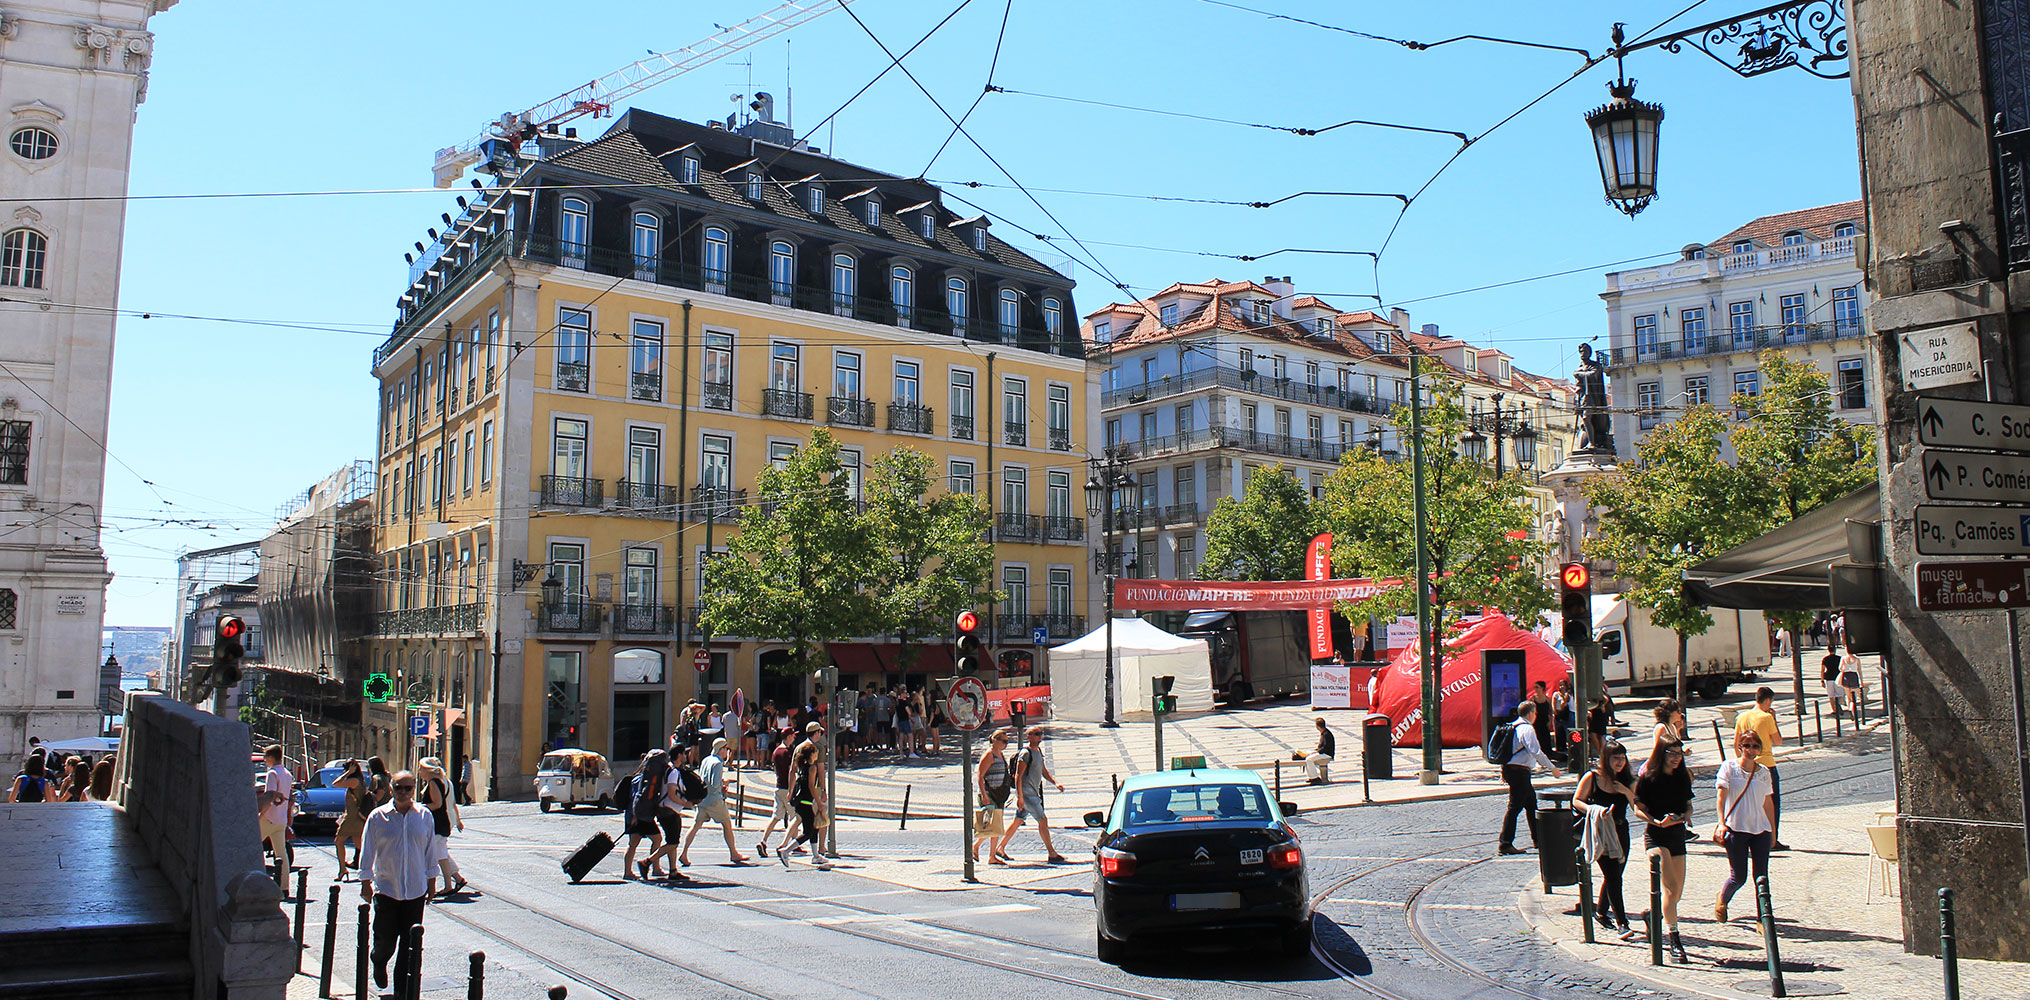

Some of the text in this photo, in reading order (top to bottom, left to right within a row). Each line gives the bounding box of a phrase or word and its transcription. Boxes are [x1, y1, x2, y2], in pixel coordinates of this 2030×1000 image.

[1928, 337, 1948, 348] RUA
[1933, 351, 1946, 362] DA
[1972, 413, 1990, 436] C.
[1957, 465, 1973, 487] P.
[1921, 520, 2015, 543] Pq. Camões
[1921, 569, 1963, 582] museu
[1316, 608, 1327, 653] FUNDACI
[414, 719, 426, 734] P
[1391, 708, 1421, 746] MAPF
